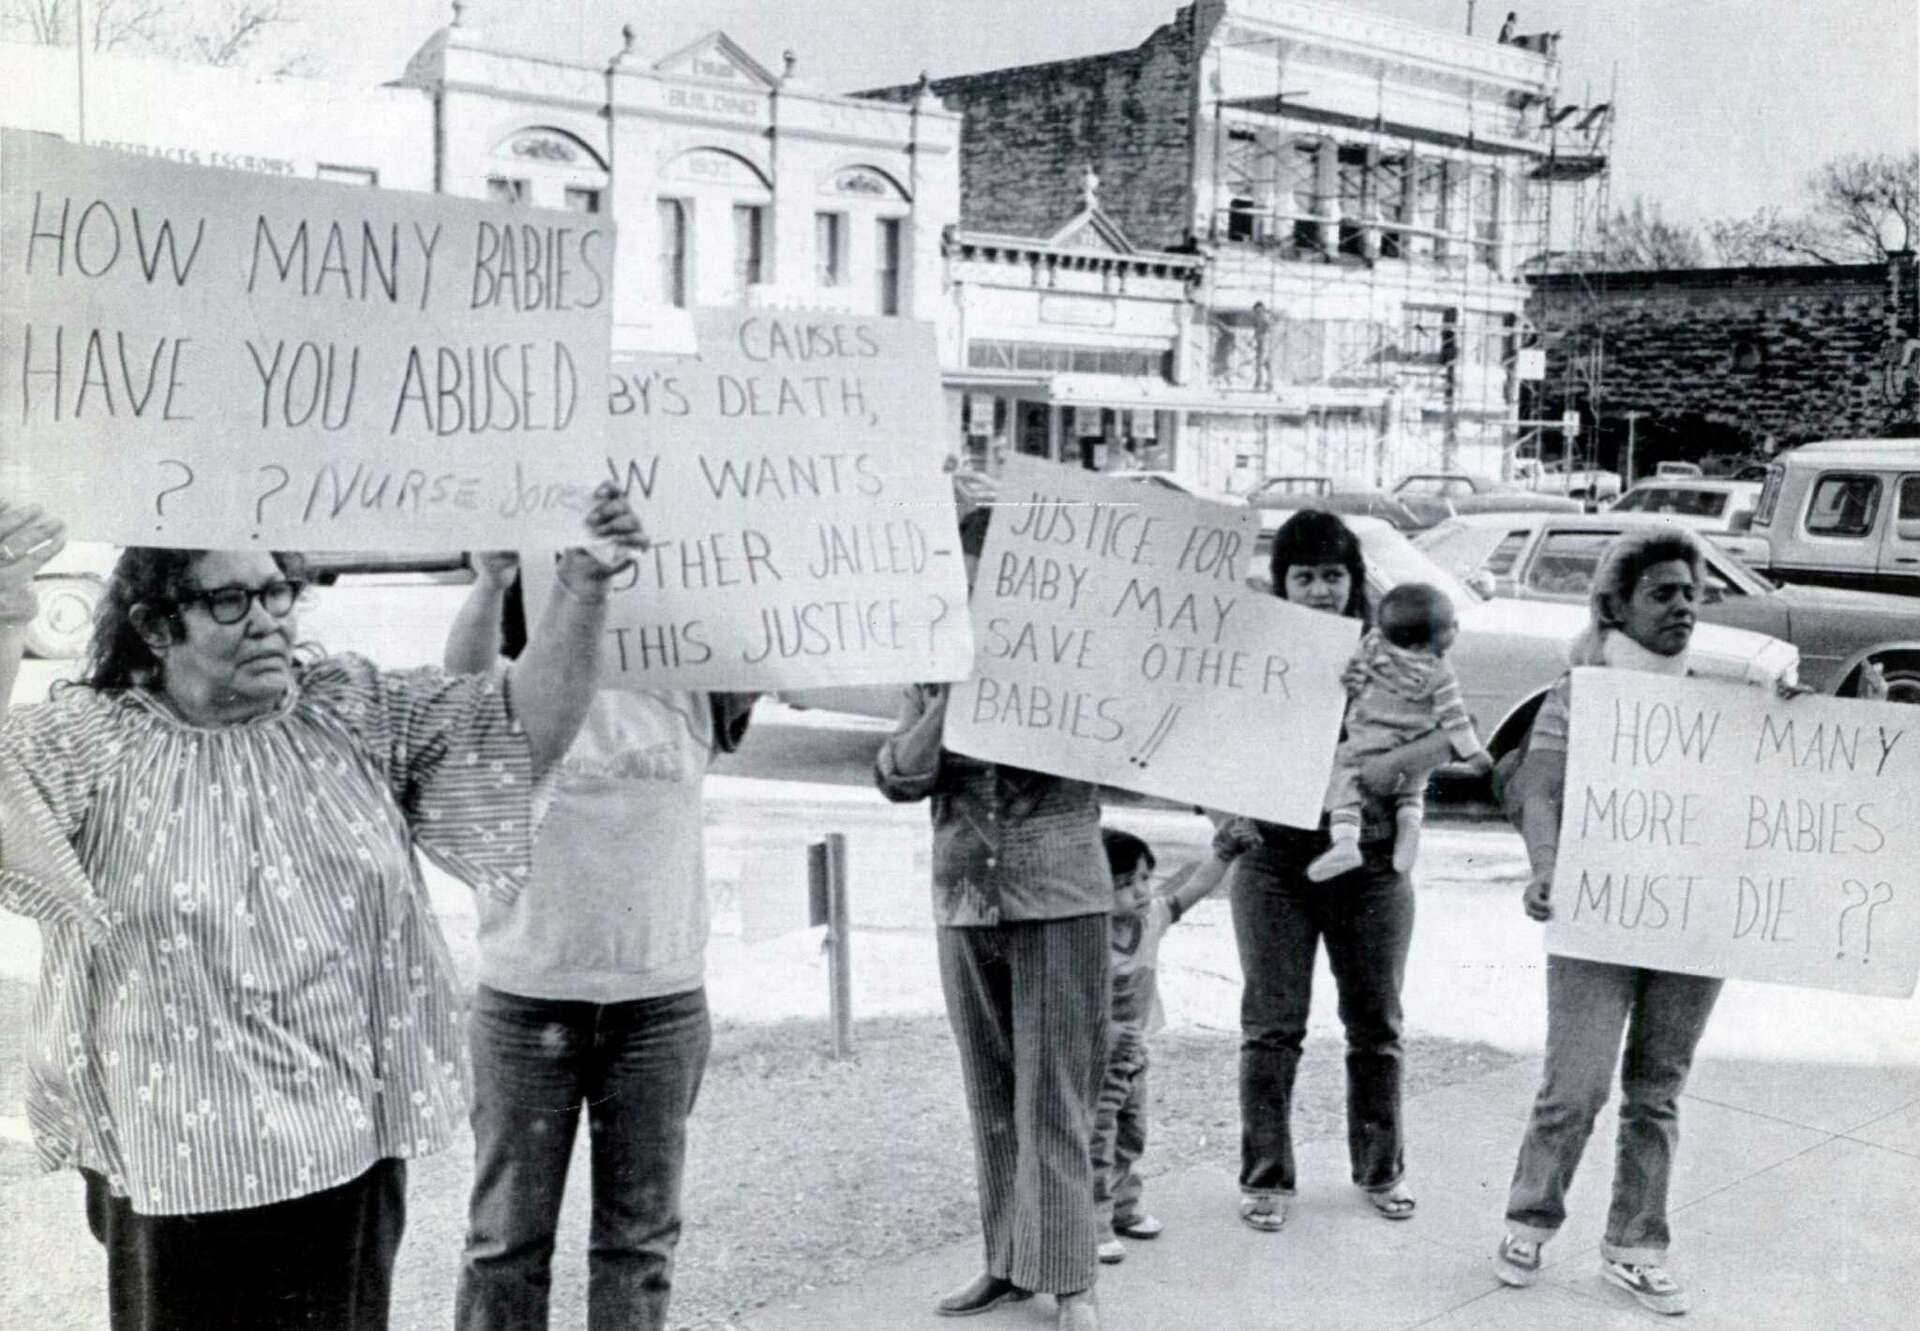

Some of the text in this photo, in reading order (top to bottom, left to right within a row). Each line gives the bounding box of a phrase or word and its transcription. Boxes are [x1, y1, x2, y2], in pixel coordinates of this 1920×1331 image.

[26, 191, 602, 310] HOW MANY BABIES
[739, 317, 880, 362] CAUSES
[22, 324, 576, 435] HAVE YOU ABUSED
[717, 374, 879, 426] DEATH,
[699, 454, 883, 500] WANTS
[1010, 492, 1242, 582] JUSTICE FOR
[996, 551, 1236, 643] BABY MAY
[608, 620, 712, 672] THIS
[984, 617, 1291, 700] SAVE OTHER
[1611, 699, 1904, 777] HOW MANY
[1582, 785, 1885, 853] MORE BABIES
[1573, 869, 1704, 931] MUST
[1733, 876, 1796, 942] DIE
